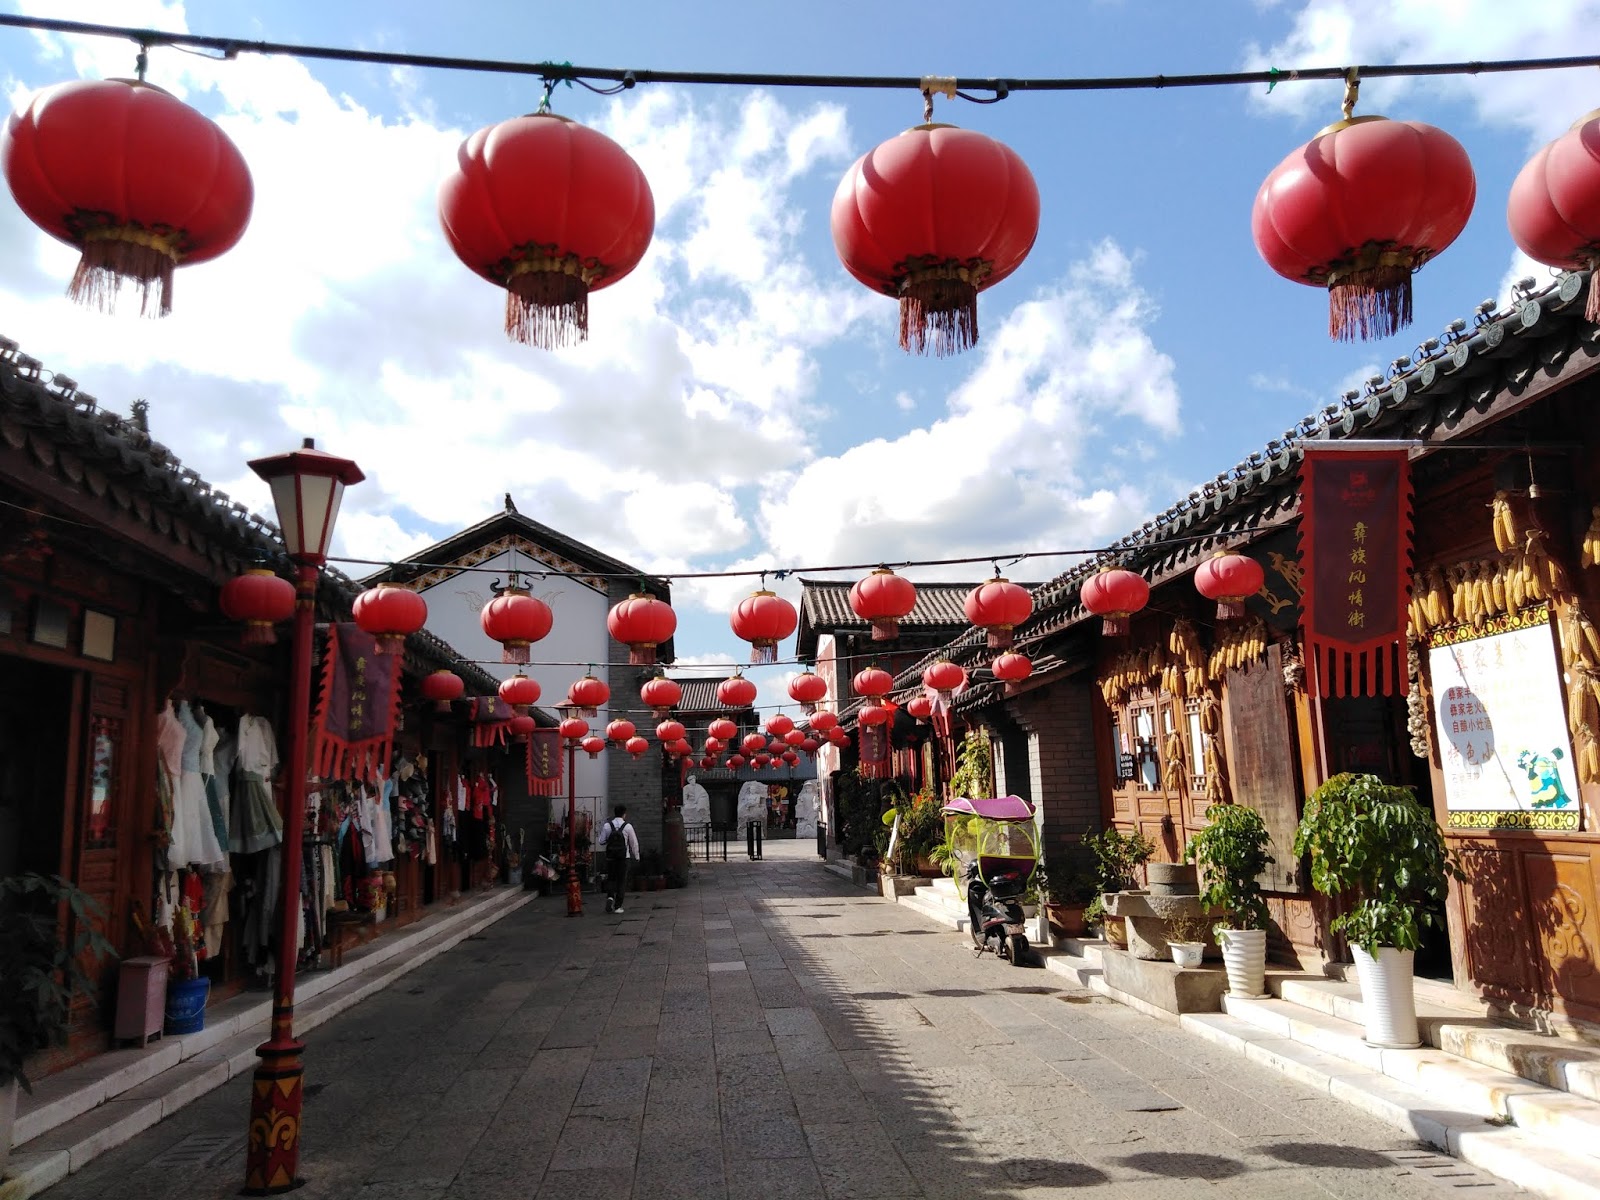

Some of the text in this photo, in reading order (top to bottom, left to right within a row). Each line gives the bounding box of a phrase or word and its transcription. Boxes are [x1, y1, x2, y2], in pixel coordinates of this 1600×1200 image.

[1348, 521, 1368, 628] 彝族风情街
